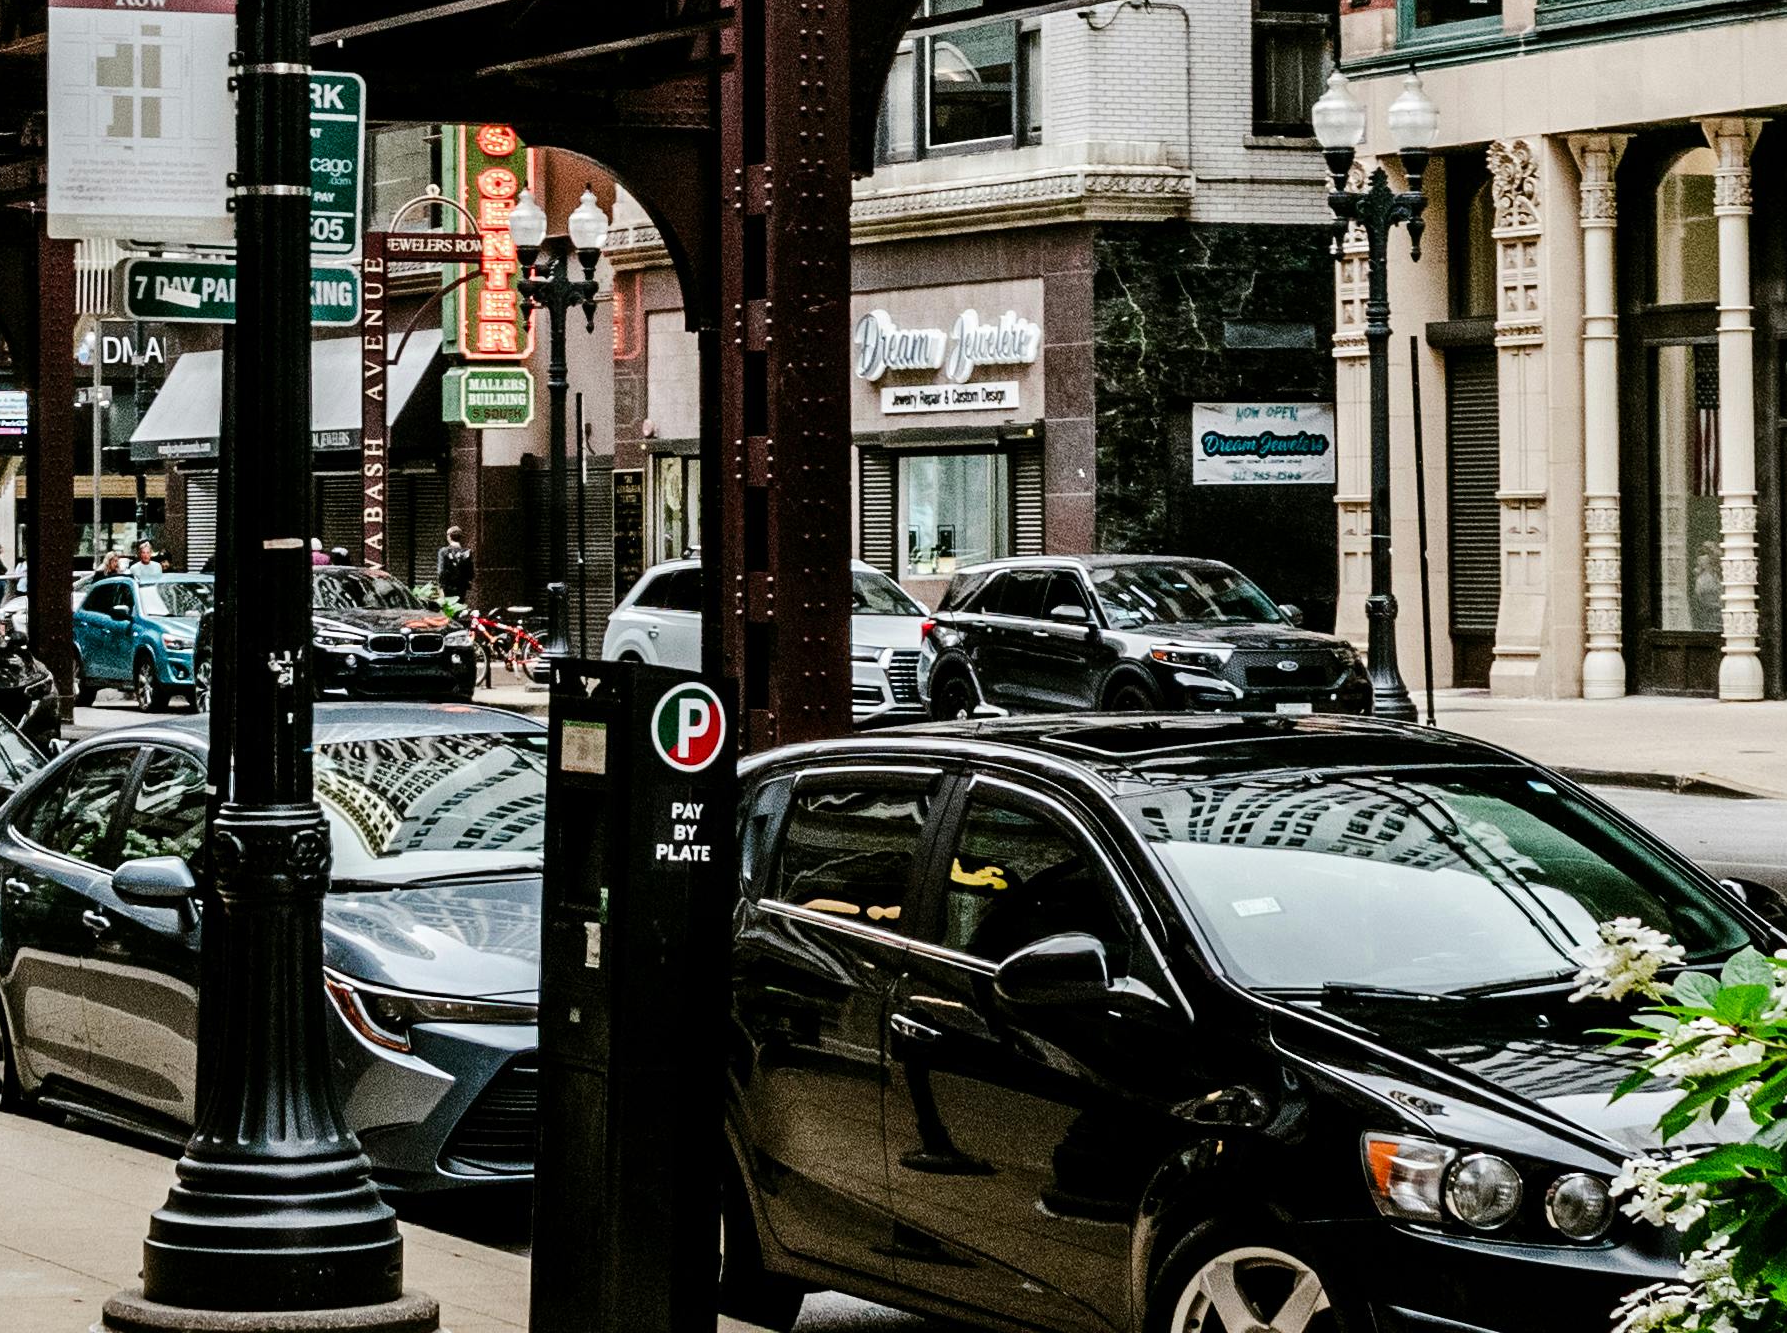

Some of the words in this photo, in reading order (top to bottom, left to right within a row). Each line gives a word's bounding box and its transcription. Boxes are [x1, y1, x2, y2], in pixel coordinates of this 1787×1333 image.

[310, 83, 345, 109] RK
[310, 157, 353, 177] cago
[455, 239, 483, 252] ROW
[477, 167, 517, 352] CENTER
[135, 276, 148, 300] 7
[365, 256, 384, 402] AVENUE
[854, 309, 948, 382] Dream
[468, 378, 527, 391] MALLERS
[468, 393, 527, 405] BUILDING
[892, 391, 917, 408] Jewelry
[919, 390, 941, 407] Repair
[952, 389, 979, 404] Custom
[982, 388, 1006, 405] Design
[484, 408, 522, 420] SOUTH
[1265, 406, 1299, 421] OPEN
[1204, 435, 1256, 453] Dream
[1259, 435, 1325, 454] Jewelers
[671, 802, 704, 820] PAY
[673, 824, 698, 841] BY
[656, 843, 711, 862] PLATE
